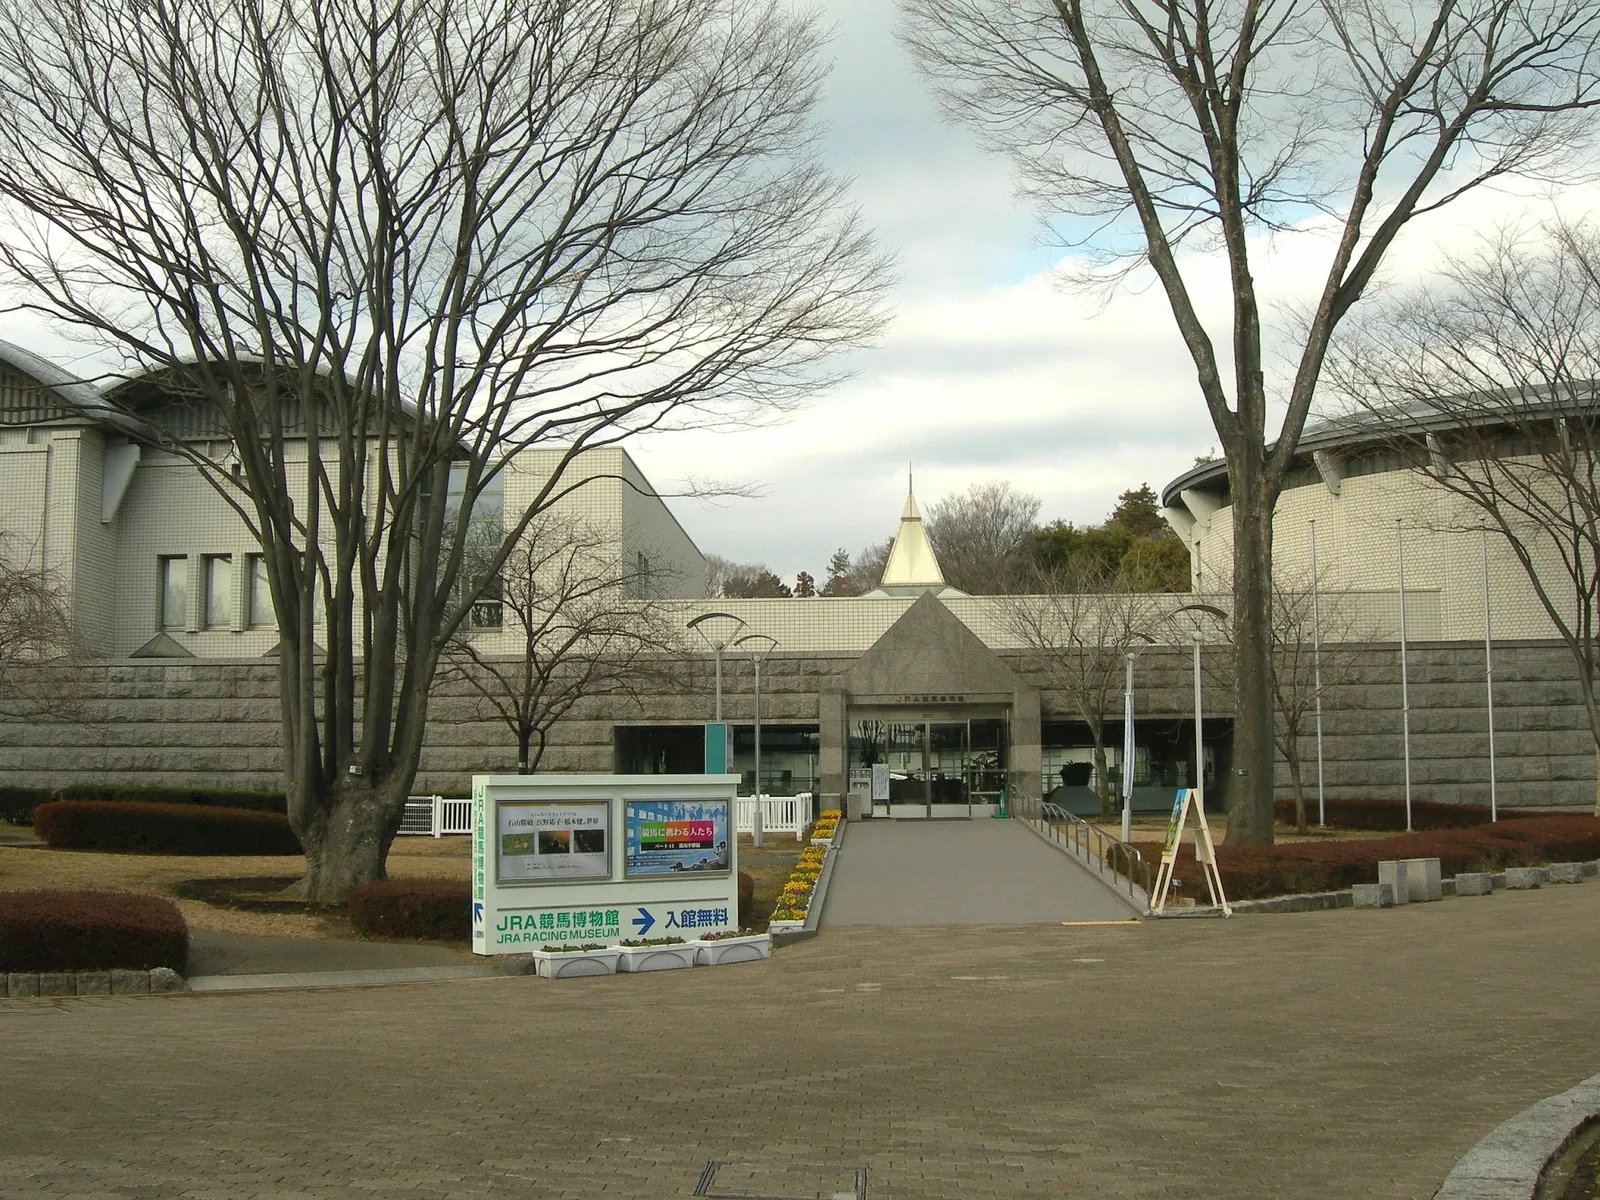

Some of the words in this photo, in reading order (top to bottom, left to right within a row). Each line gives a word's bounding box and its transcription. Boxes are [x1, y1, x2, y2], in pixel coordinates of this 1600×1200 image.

[641, 827, 713, 838] 競馬に携わる人たち
[496, 909, 620, 931] JRA競馬博物館
[664, 907, 729, 929] 入館無料
[496, 933, 521, 944] JRA
[523, 930, 568, 942] RACING
[569, 927, 620, 940] MUSEUM
